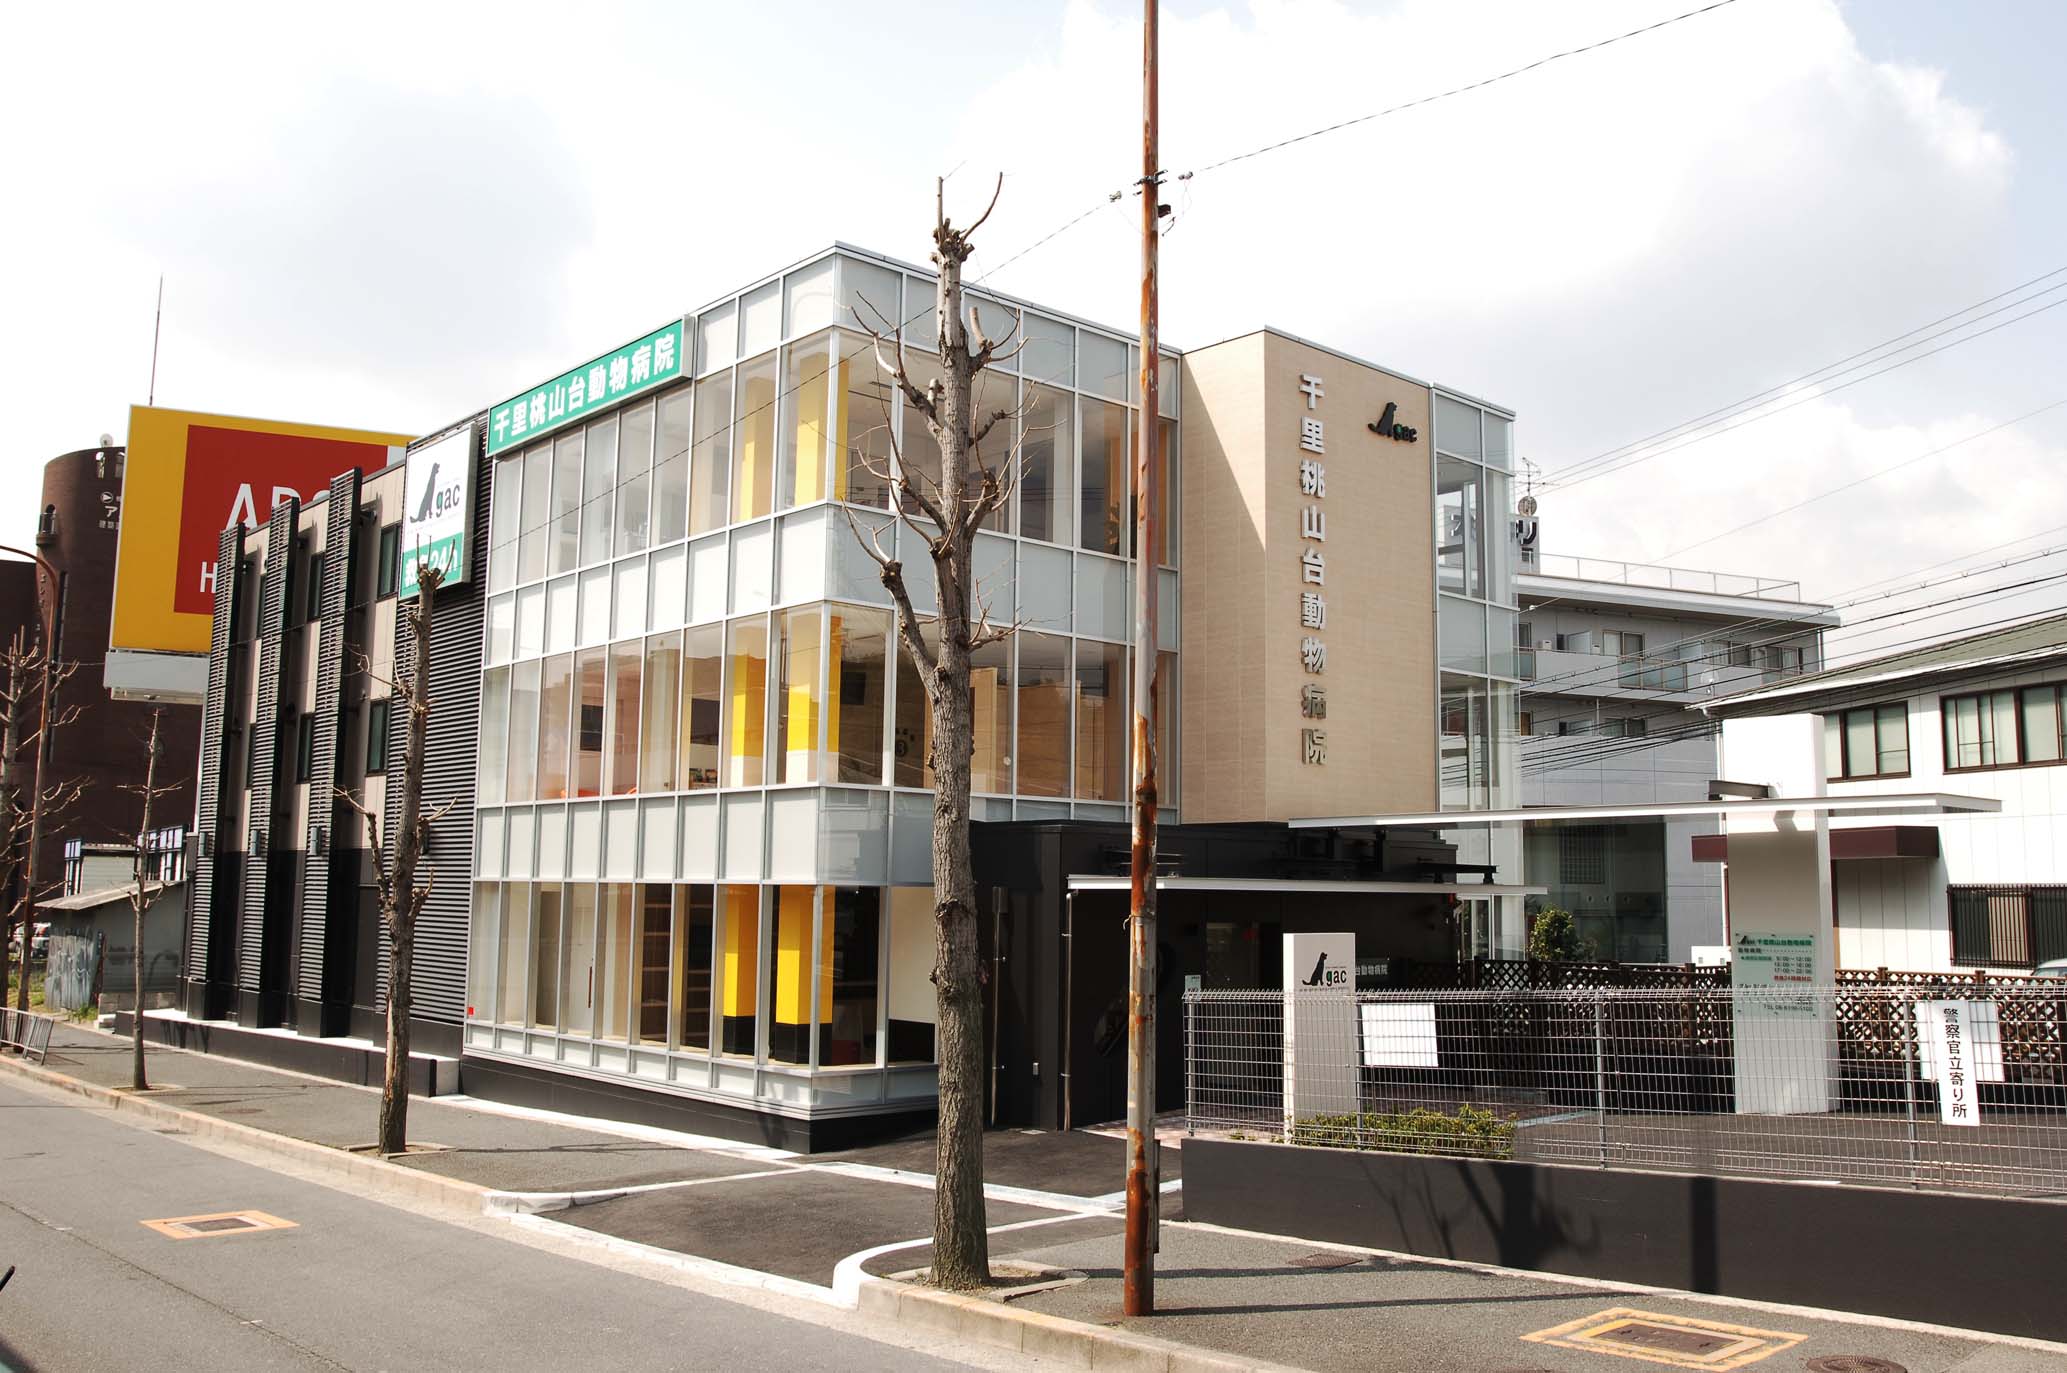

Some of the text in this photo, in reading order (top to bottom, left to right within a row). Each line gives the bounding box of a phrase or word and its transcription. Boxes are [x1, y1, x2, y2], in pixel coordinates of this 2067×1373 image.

[494, 333, 675, 442] 千里桃山台動物病院
[436, 484, 460, 518] gac
[1299, 373, 1328, 766] 千里桃山台動物病院
[1326, 970, 1347, 987] gac
[1943, 1008, 1968, 1119] 警察官立寄り所
